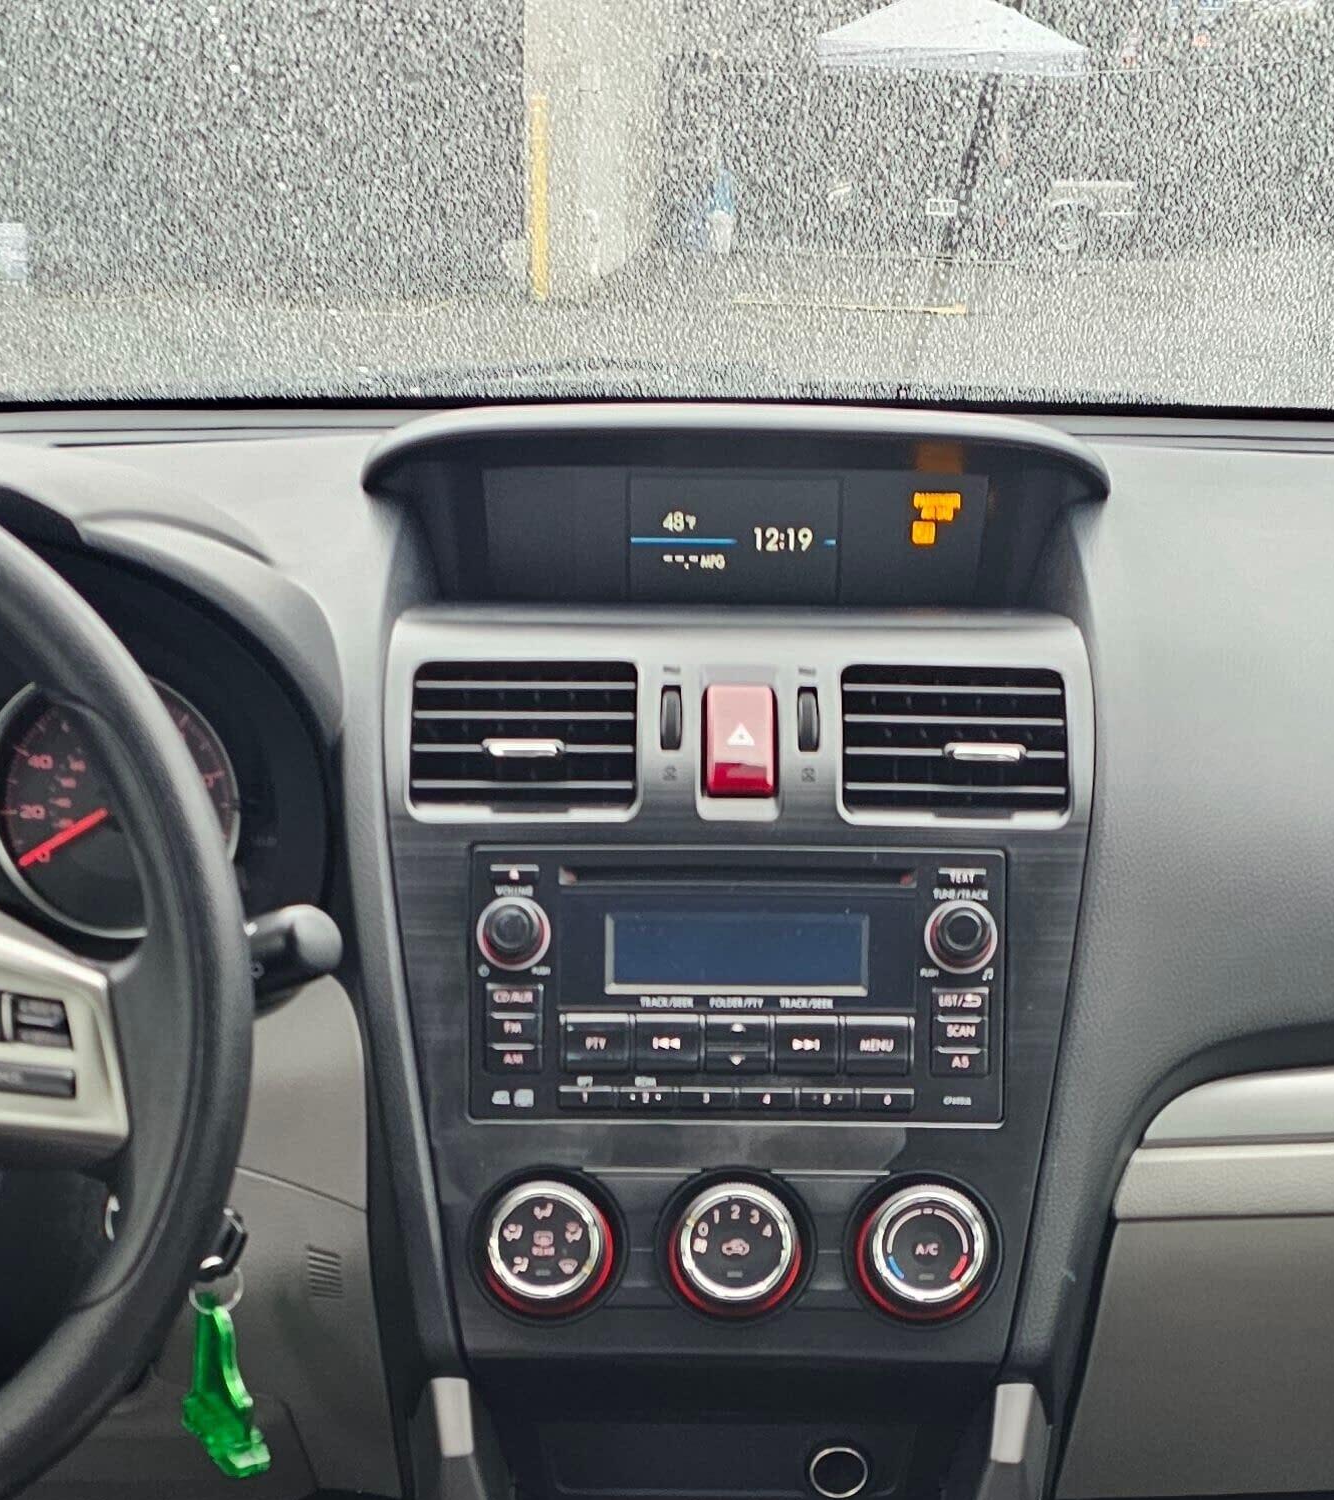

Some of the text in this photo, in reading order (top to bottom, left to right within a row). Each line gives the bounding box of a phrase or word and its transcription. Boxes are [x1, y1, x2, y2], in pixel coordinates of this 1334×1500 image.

[753, 526, 814, 552] 12:19
[19, 804, 46, 821] 20
[503, 1020, 523, 1034] FM
[946, 1024, 976, 1038] SCAN
[585, 1036, 607, 1050] PTY
[859, 1038, 895, 1052] MENU
[502, 1053, 525, 1065] AM
[713, 1208, 720, 1225] 1
[730, 1204, 741, 1220] 2
[749, 1208, 760, 1225] 3
[697, 1221, 709, 1237] 0
[762, 1223, 773, 1238] 4
[914, 1243, 939, 1256] A/C
